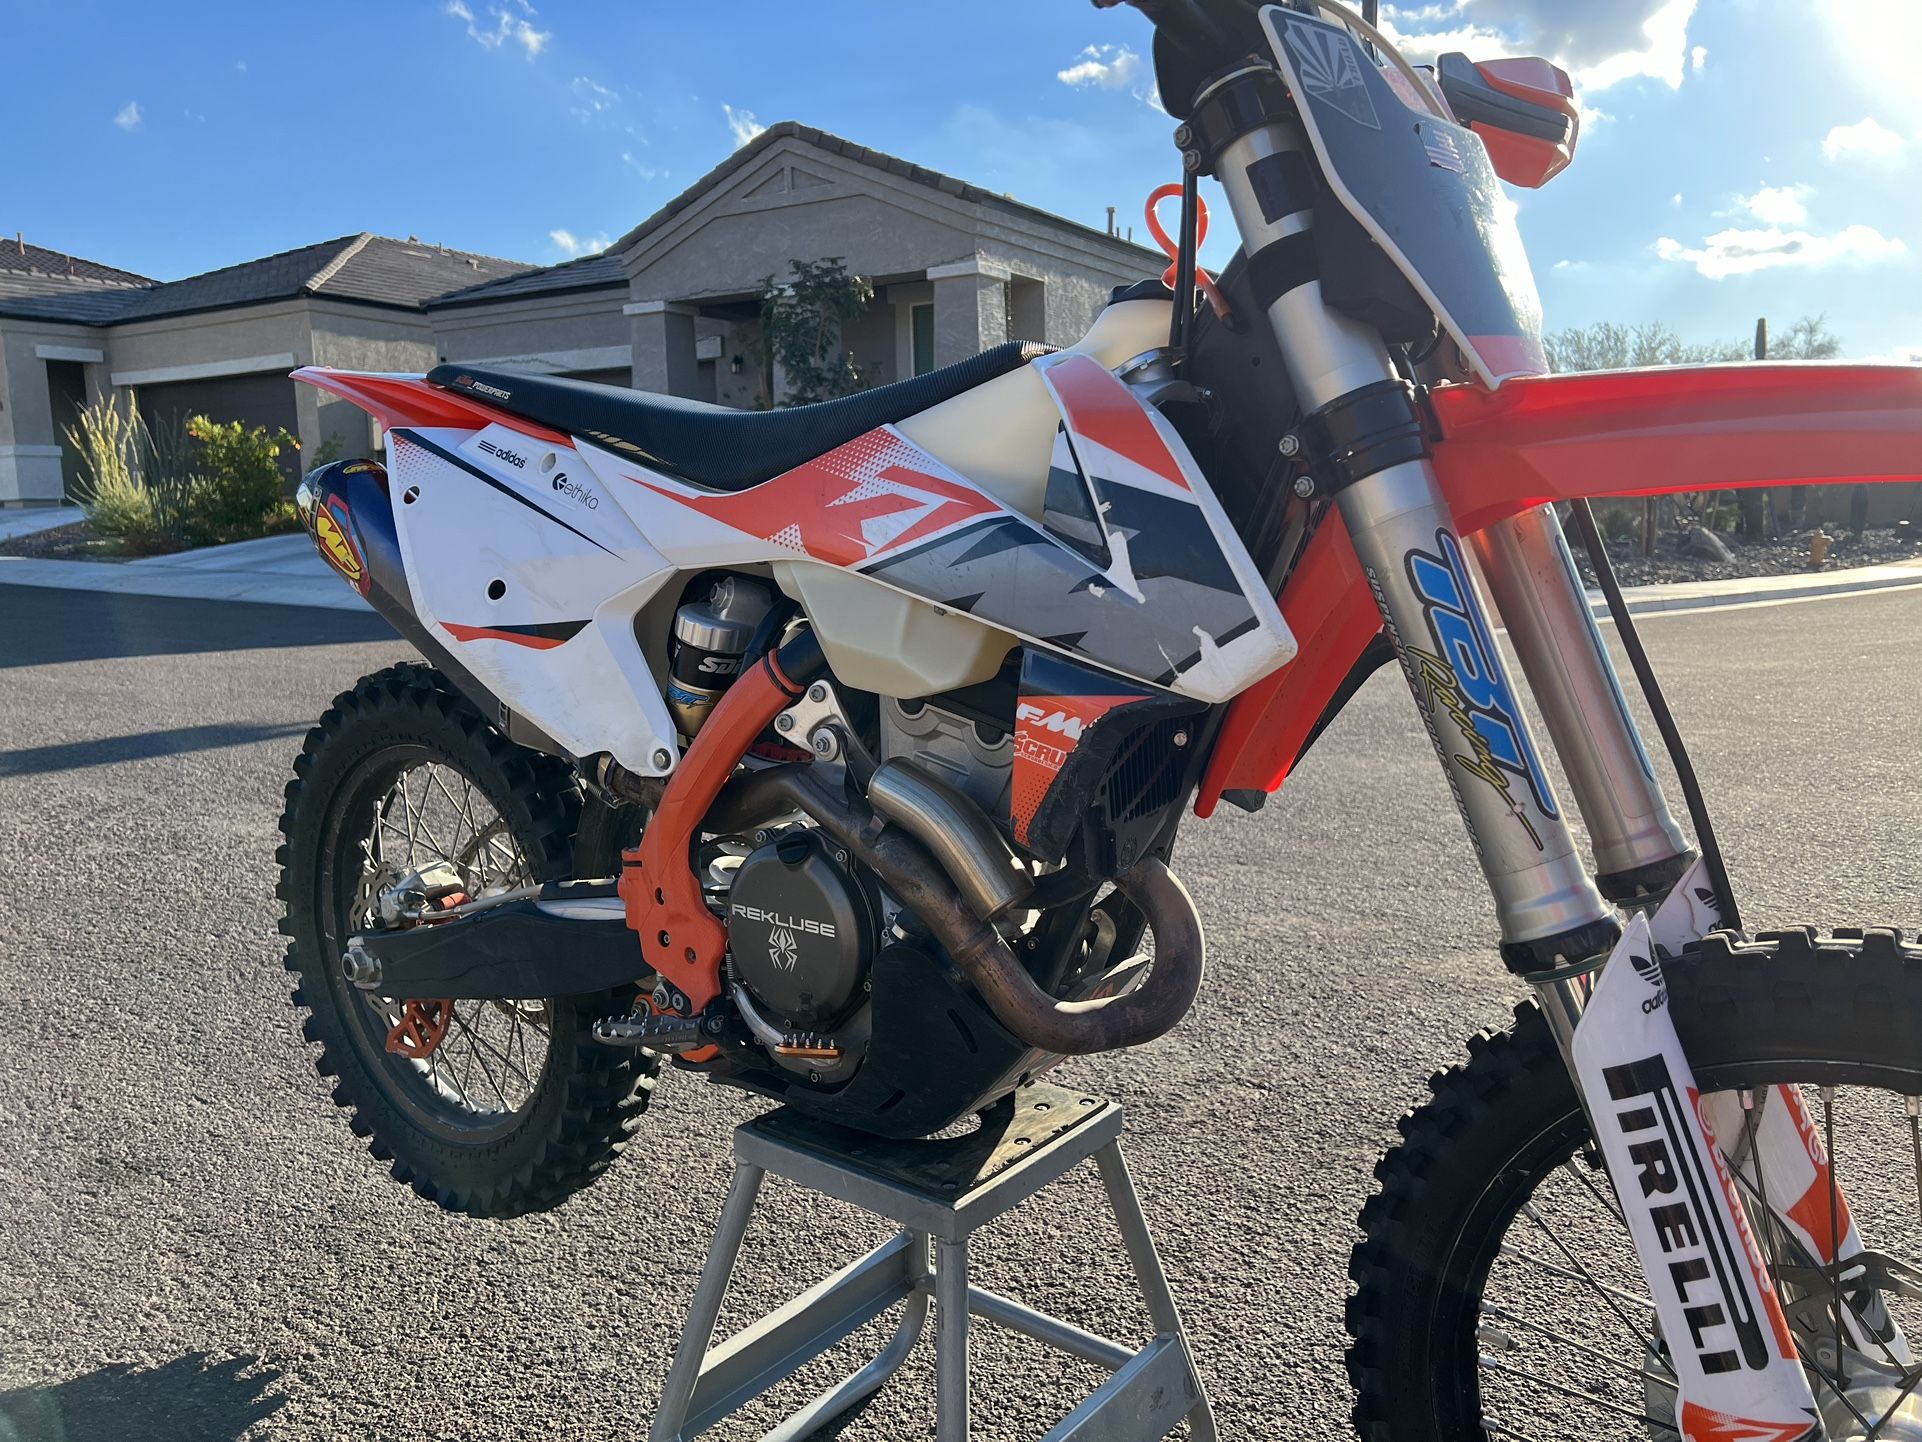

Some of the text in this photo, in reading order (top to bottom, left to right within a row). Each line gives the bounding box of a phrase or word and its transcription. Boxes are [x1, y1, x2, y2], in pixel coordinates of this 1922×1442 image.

[495, 447, 527, 469] adidas
[563, 480, 600, 511] ethika
[1366, 565, 1415, 676] SUSPENSION
[1417, 701, 1447, 761] ENGINE
[1442, 765, 1485, 857] SERVICES
[731, 903, 836, 938] REKLUSE
[1602, 1053, 1769, 1376] PIRELLI
